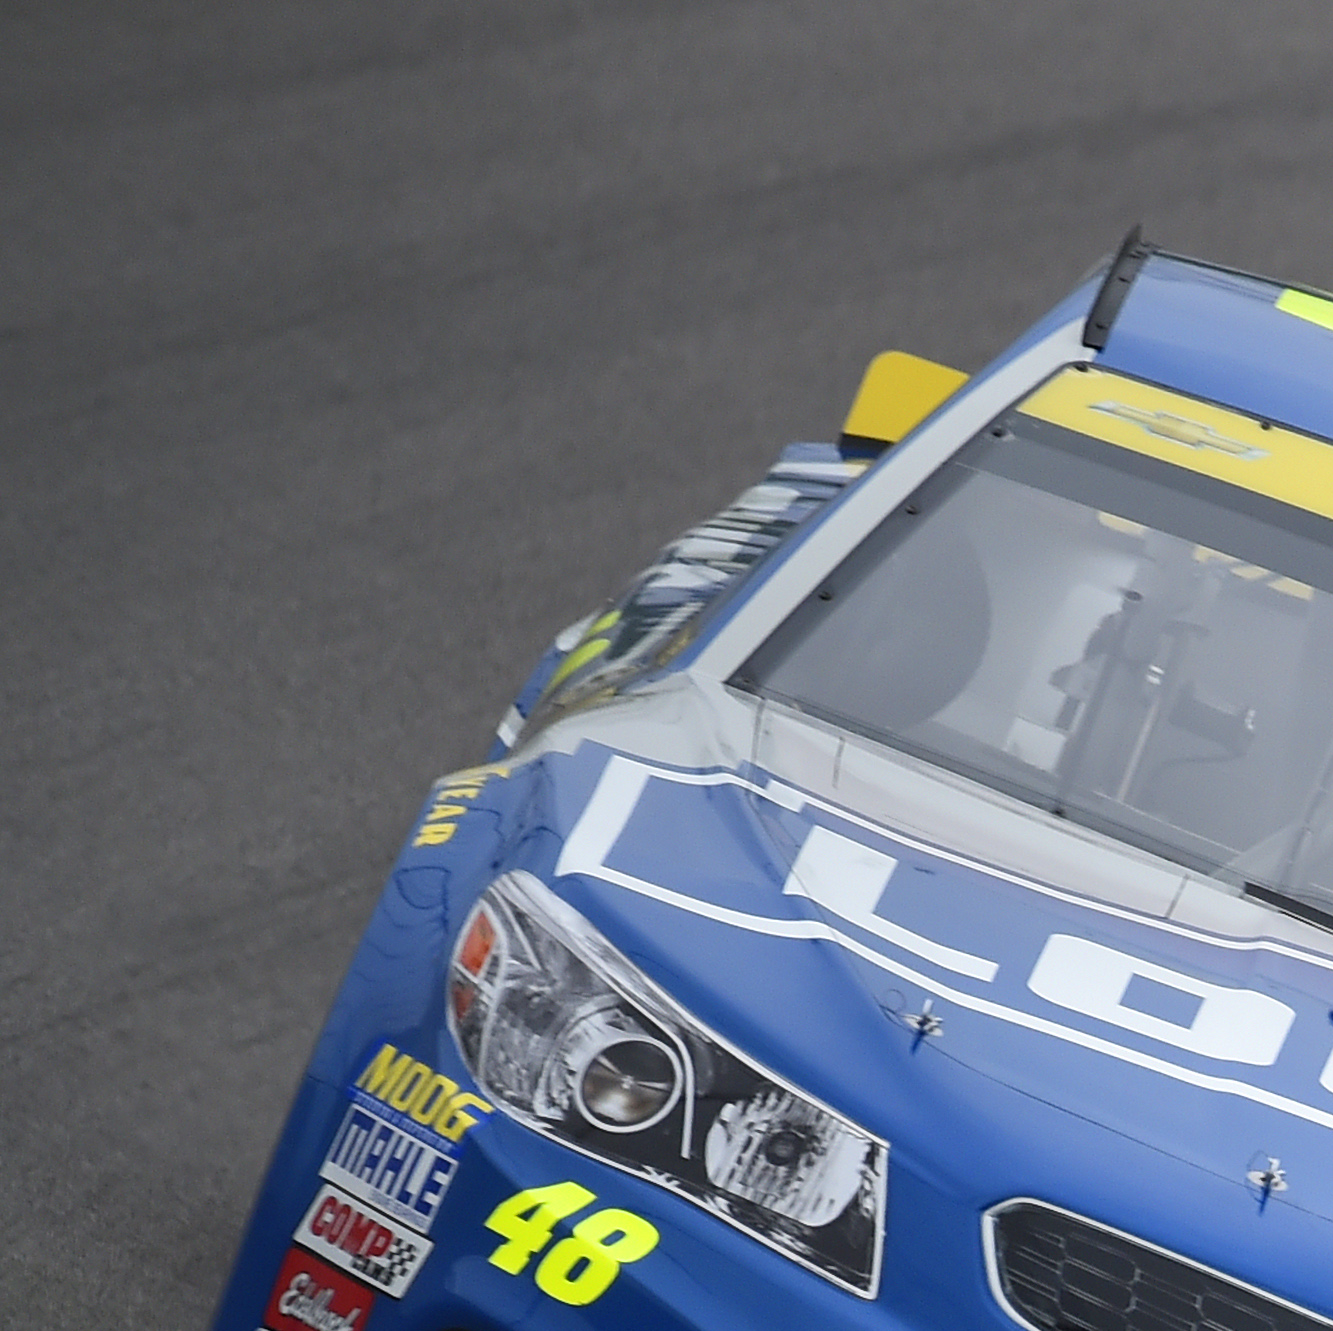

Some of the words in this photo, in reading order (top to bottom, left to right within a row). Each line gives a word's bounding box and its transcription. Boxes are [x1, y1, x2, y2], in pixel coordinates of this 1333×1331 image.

[354, 1042, 496, 1143] MOOG
[331, 1109, 453, 1218] MAHLE
[311, 1195, 394, 1258] COMP
[483, 1180, 661, 1307] 48
